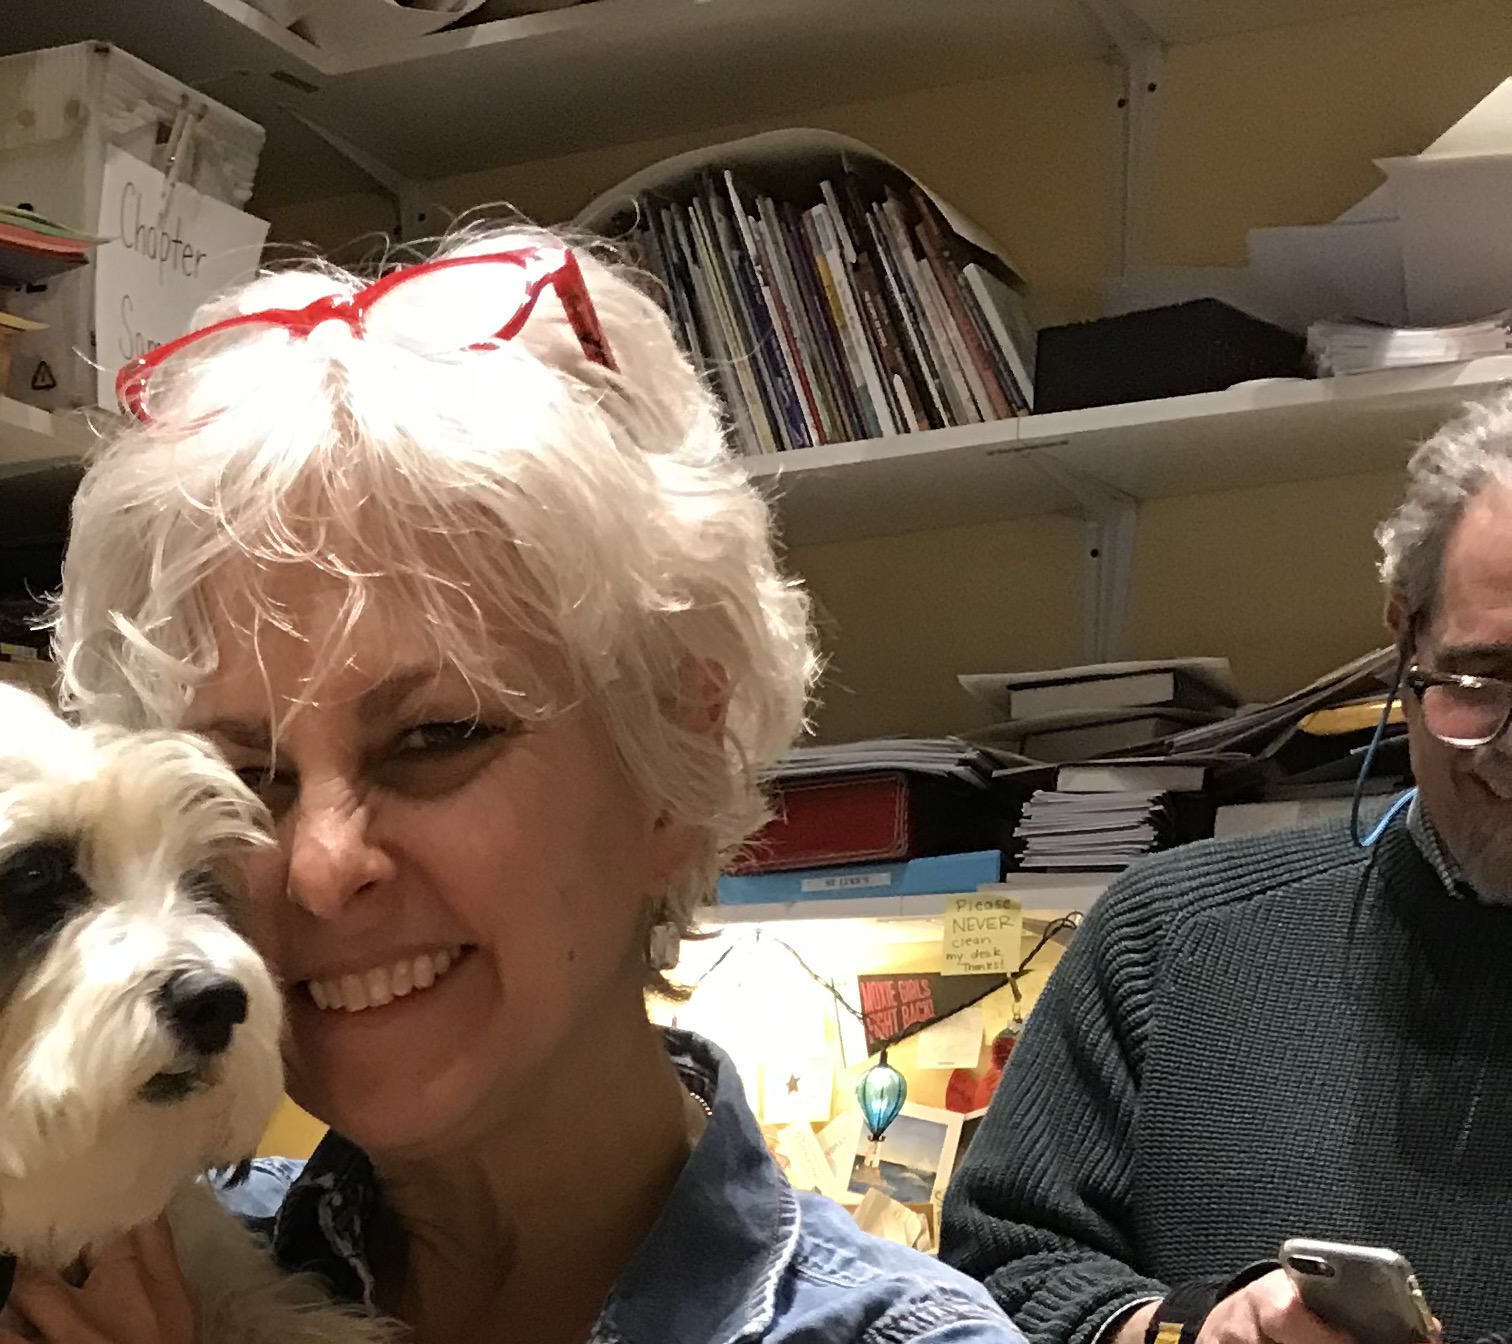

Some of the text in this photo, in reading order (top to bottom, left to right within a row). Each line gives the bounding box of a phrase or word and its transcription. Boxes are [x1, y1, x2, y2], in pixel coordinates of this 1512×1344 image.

[120, 181, 207, 286] Chapter
[955, 897, 1011, 911] Please
[951, 915, 1015, 934] NEVER
[951, 936, 992, 949] clean
[945, 953, 964, 965] my
